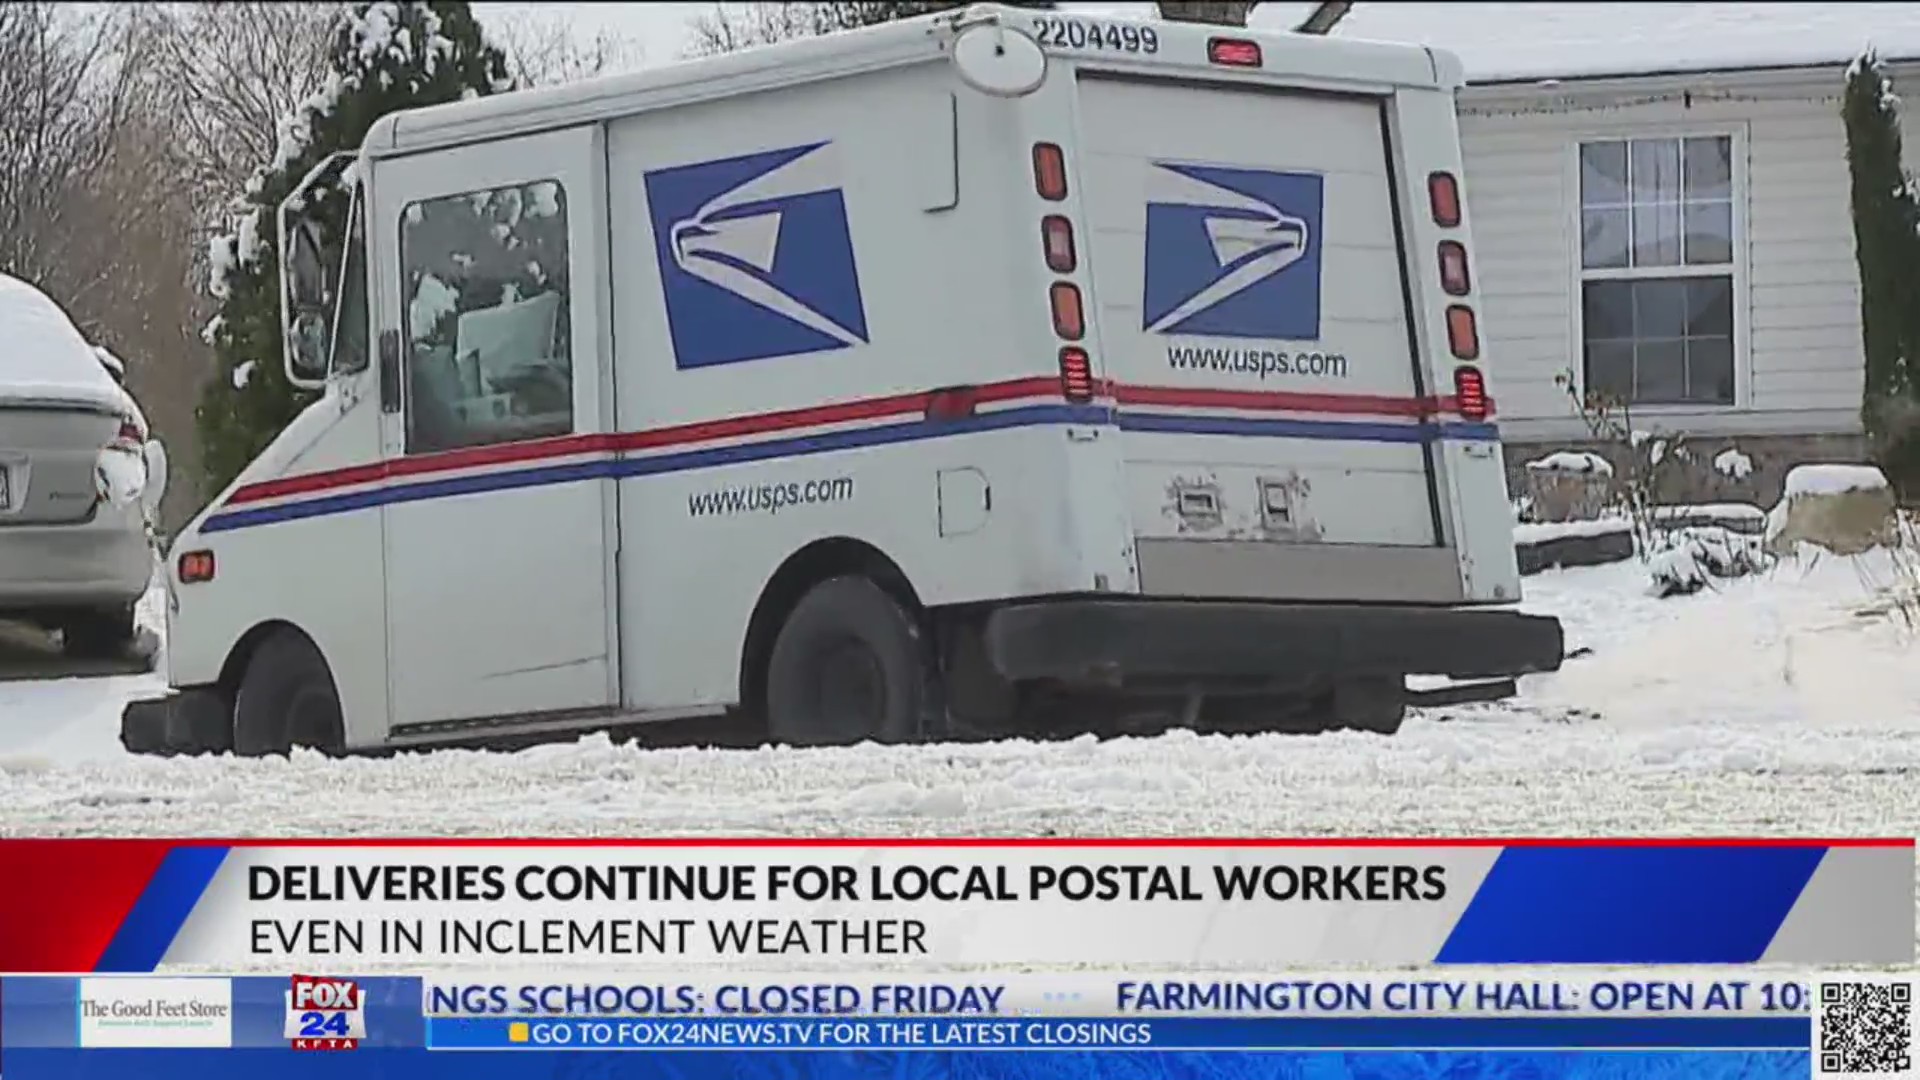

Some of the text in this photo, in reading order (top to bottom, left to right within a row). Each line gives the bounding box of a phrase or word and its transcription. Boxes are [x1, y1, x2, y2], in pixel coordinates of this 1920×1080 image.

[1033, 19, 1158, 53] 2204499
[1168, 346, 1347, 380] www.usps.com
[688, 477, 853, 516] www.usps.com
